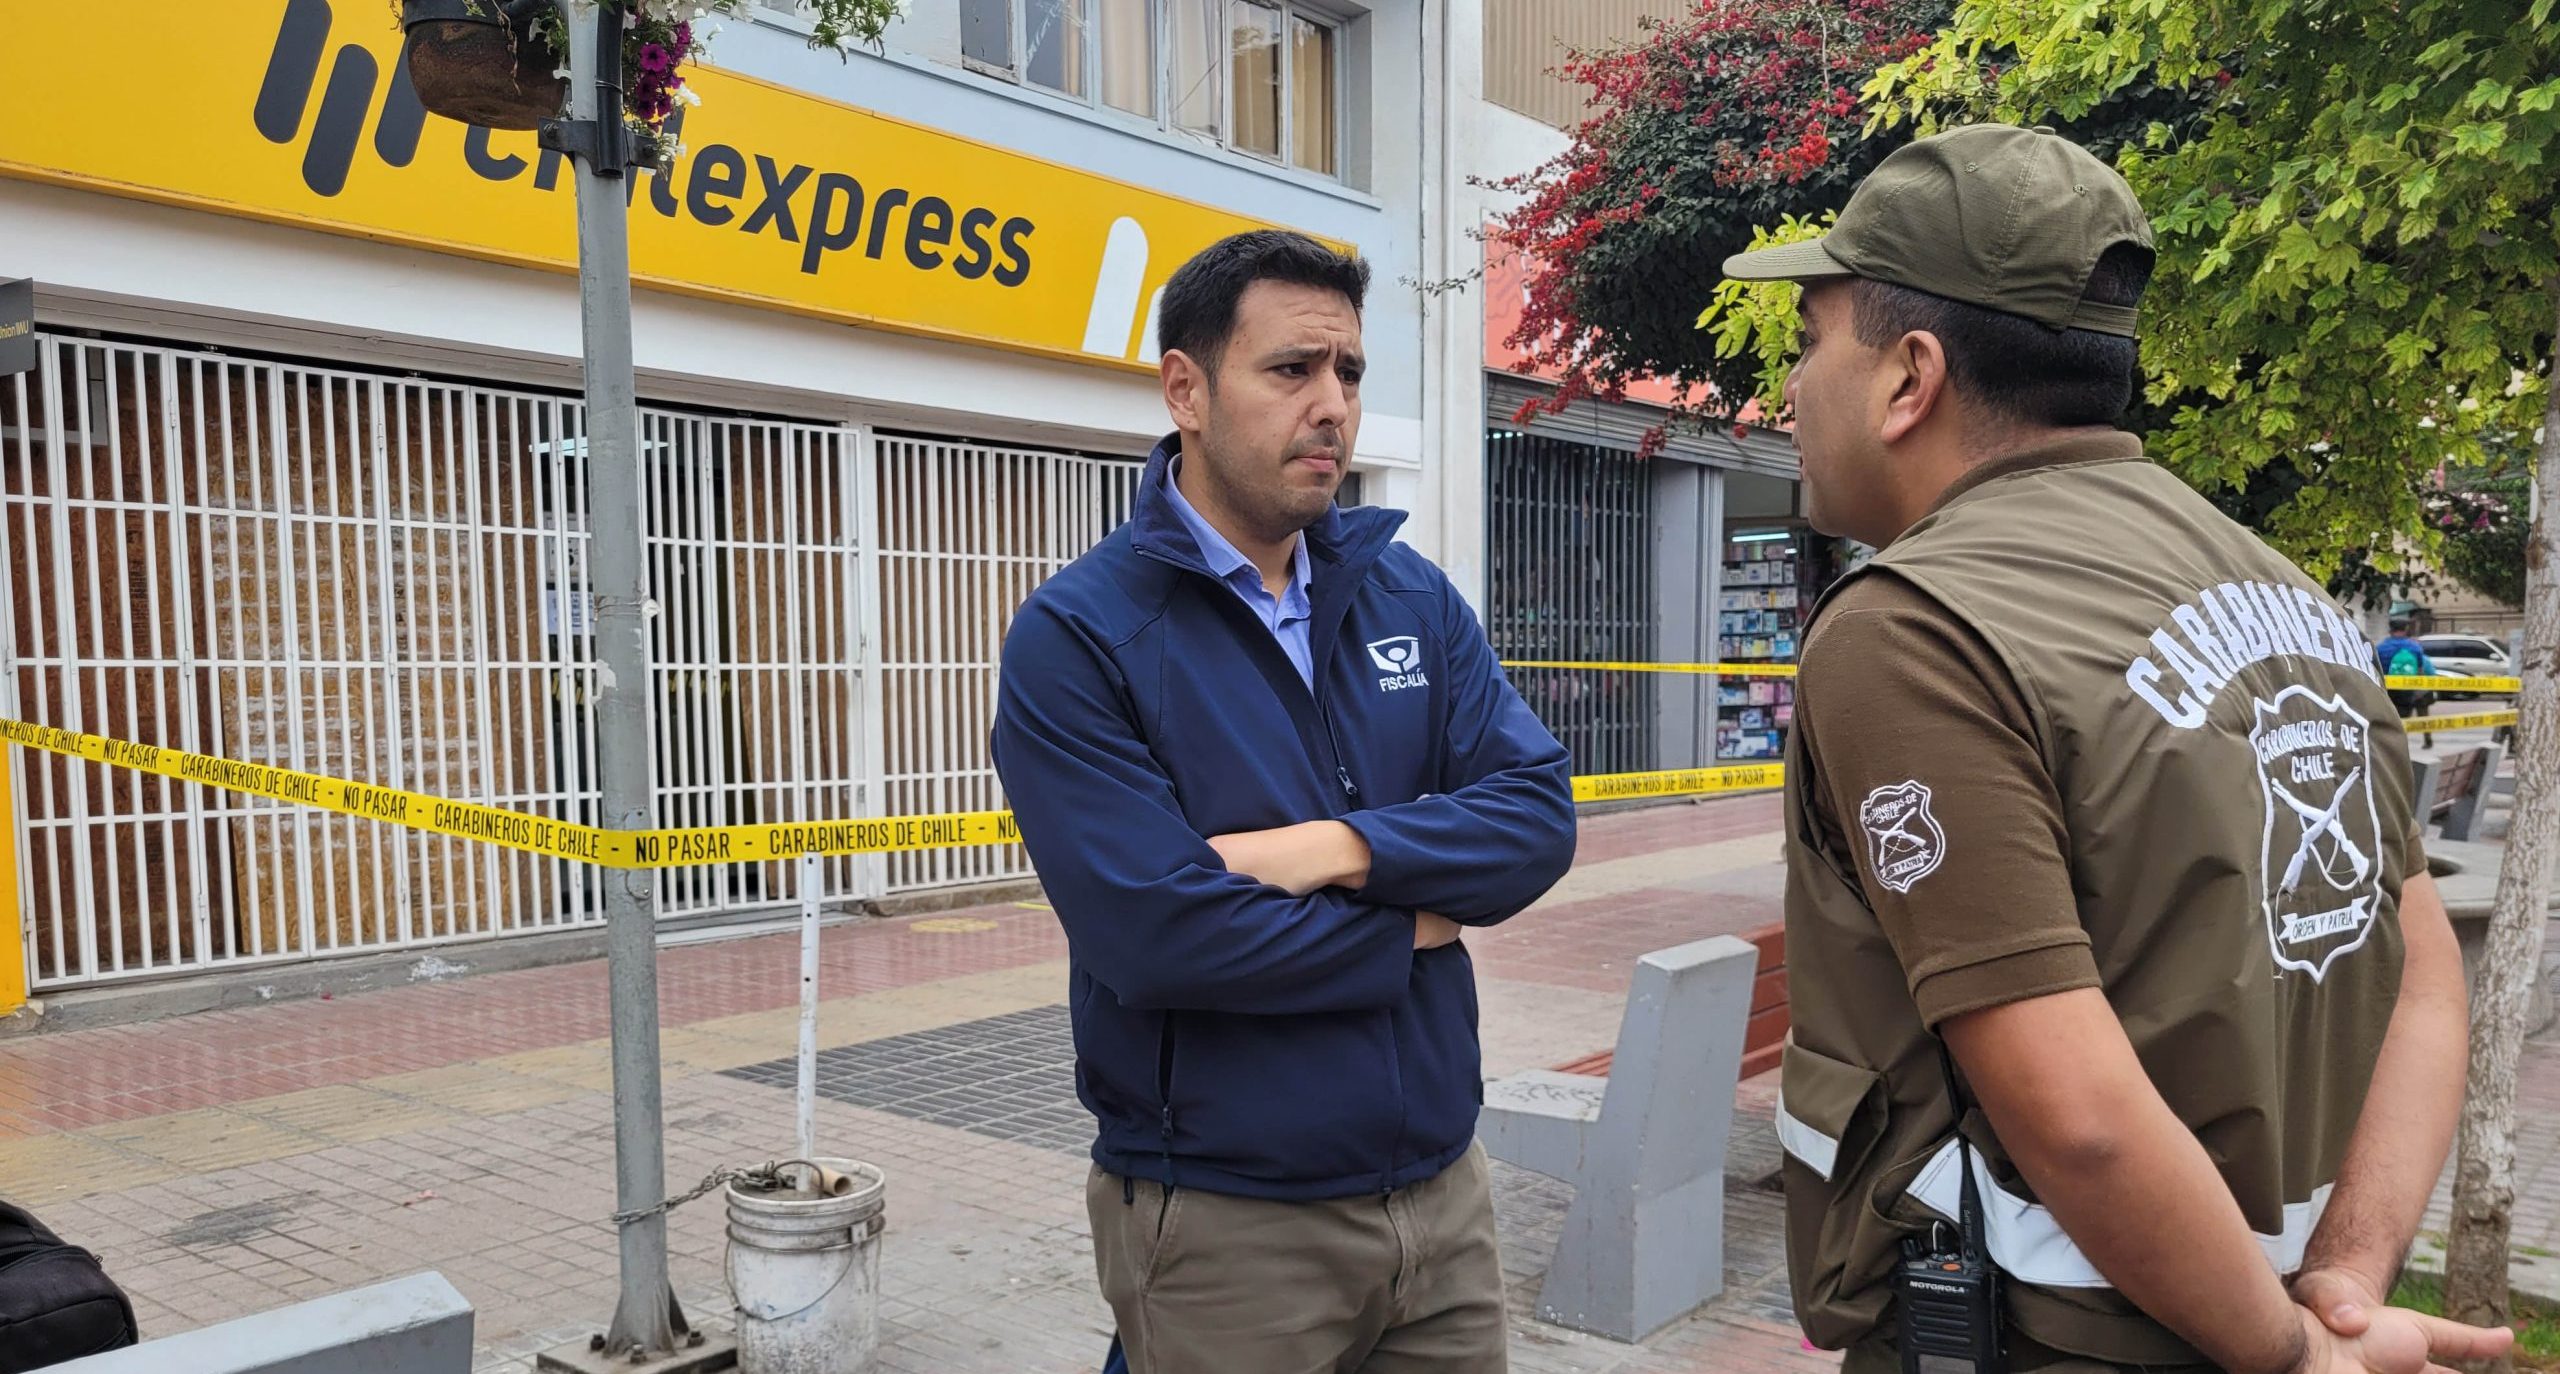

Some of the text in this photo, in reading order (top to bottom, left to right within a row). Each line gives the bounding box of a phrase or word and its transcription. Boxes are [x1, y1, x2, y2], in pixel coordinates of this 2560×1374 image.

[464, 104, 1036, 288] clexpress
[1379, 668, 1429, 692] FISCALÍA
[2340, 724, 2360, 754] DE
[1594, 767, 1765, 796] CARABINEROS DE CHILE NO PASAR
[2291, 752, 2335, 784] CHILE
[37, 726, 50, 747] DE
[53, 729, 84, 754] CHILE
[103, 738, 119, 760] NO
[120, 741, 160, 769] PASAR
[181, 753, 262, 790] CARABINEROS
[265, 770, 282, 795] DE
[284, 774, 321, 803] CHILE
[343, 785, 360, 810] NO
[363, 788, 408, 820] PASAR
[434, 803, 530, 845] CARABINEROS
[535, 822, 552, 850] DE
[558, 827, 600, 859] CHILE
[635, 836, 660, 863] NO
[668, 832, 731, 861] PASAR
[769, 823, 890, 855] CARABINEROS
[896, 821, 915, 847] DE
[922, 818, 967, 844] CHILE
[997, 815, 1017, 839] NO
[2292, 920, 2316, 939] ORDEN
[1909, 1281, 1966, 1294] MOTOROLA
